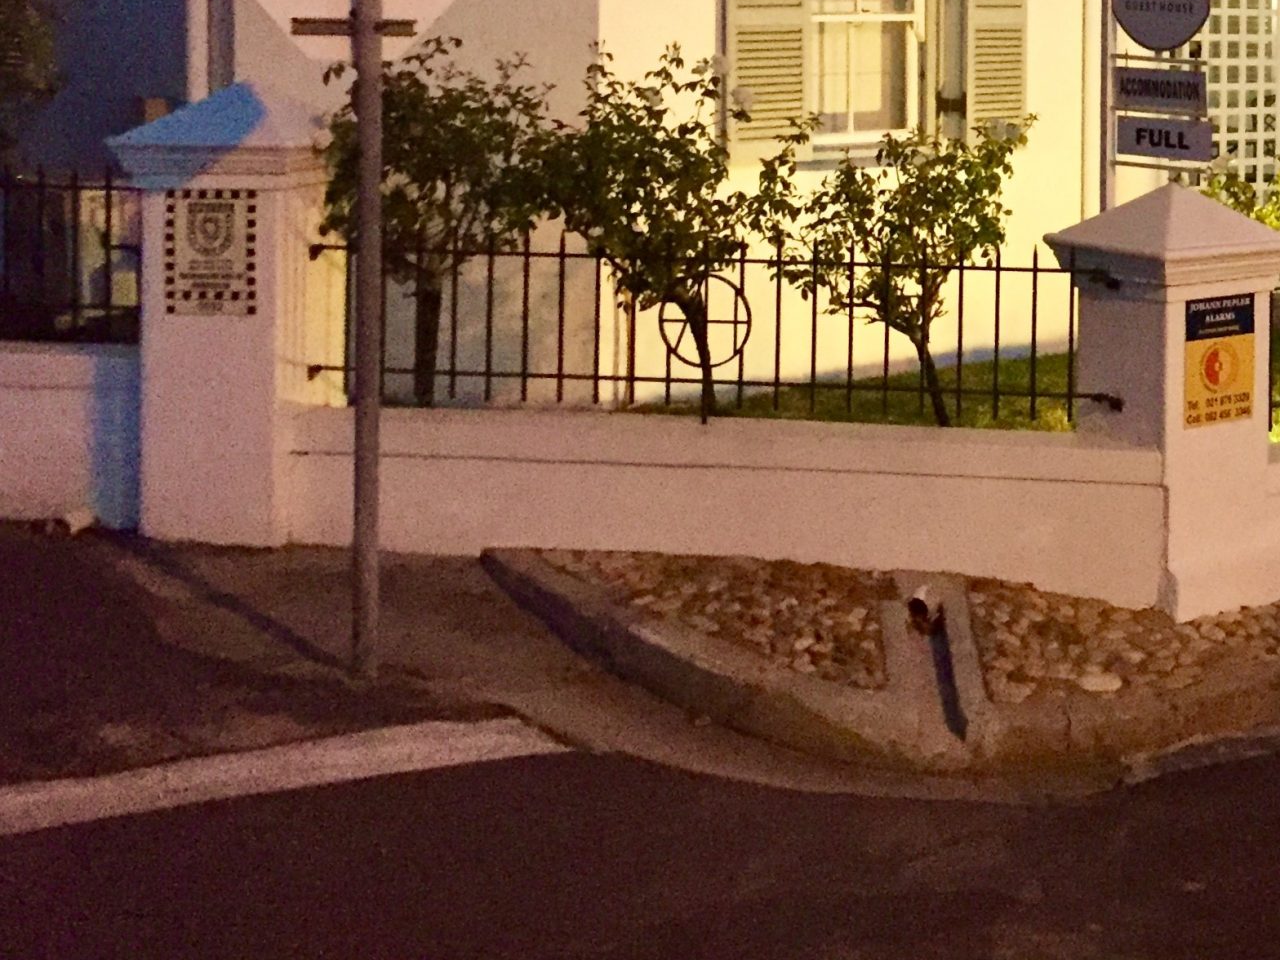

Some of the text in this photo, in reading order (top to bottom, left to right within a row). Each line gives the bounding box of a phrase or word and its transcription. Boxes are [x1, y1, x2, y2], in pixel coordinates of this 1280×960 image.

[1119, 76, 1200, 101] ACCOMMODATION
[1135, 127, 1190, 150] FULL
[1189, 300, 1222, 314] JOHANN
[1205, 311, 1236, 323] ALARMS
